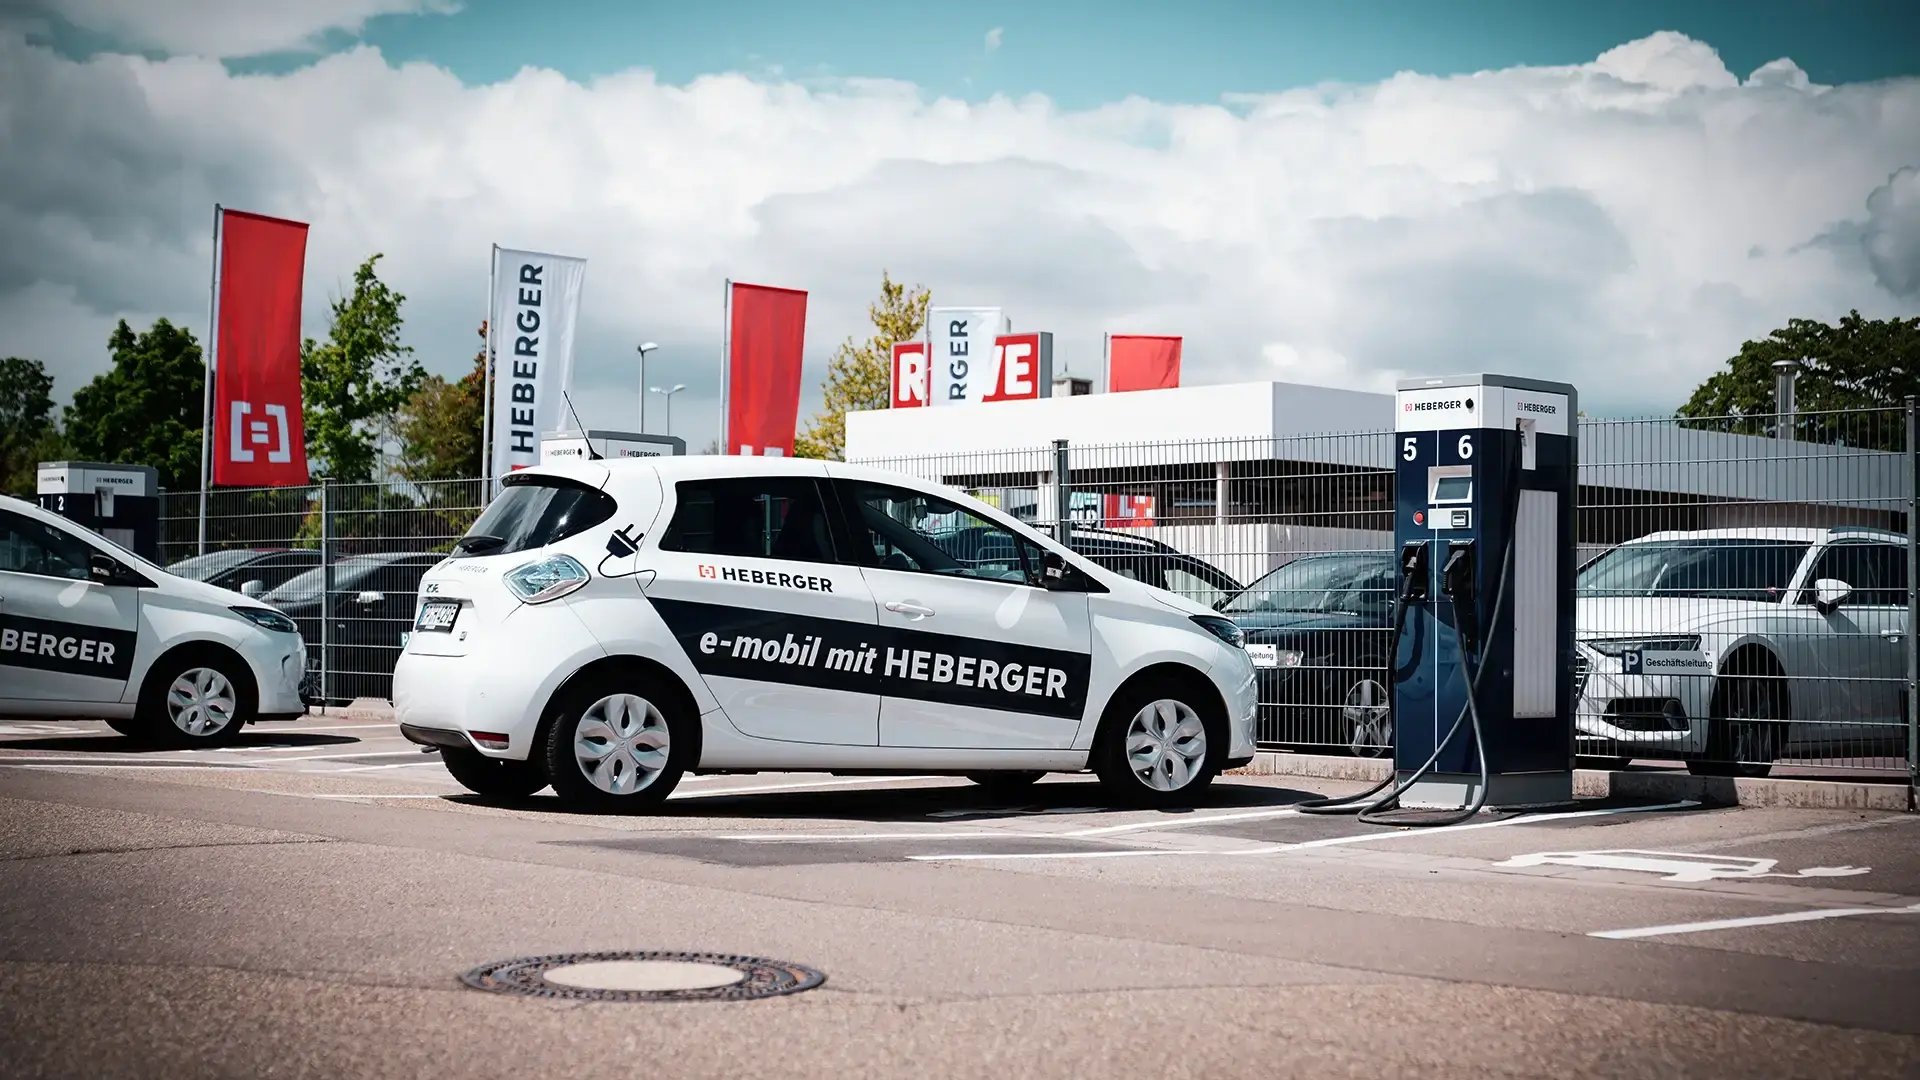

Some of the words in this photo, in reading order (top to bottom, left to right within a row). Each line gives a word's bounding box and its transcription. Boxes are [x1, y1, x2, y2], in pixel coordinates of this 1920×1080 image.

[511, 263, 543, 453] HEBERGER
[1415, 400, 1461, 411] HEBERGER
[1523, 402, 1556, 414] HEBERGER
[1403, 437, 1417, 461] 5
[1458, 434, 1473, 459] 6
[102, 477, 134, 485] HEBERGER
[58, 496, 64, 510] 2
[722, 567, 833, 593] HEBERGER
[0, 628, 116, 665] BERGER
[700, 631, 822, 667] e-mobil
[825, 643, 877, 675] mit
[884, 647, 1068, 699] HEBERGER
[1625, 652, 1639, 672] P
[1646, 658, 1713, 669] Geschäftsleitung
